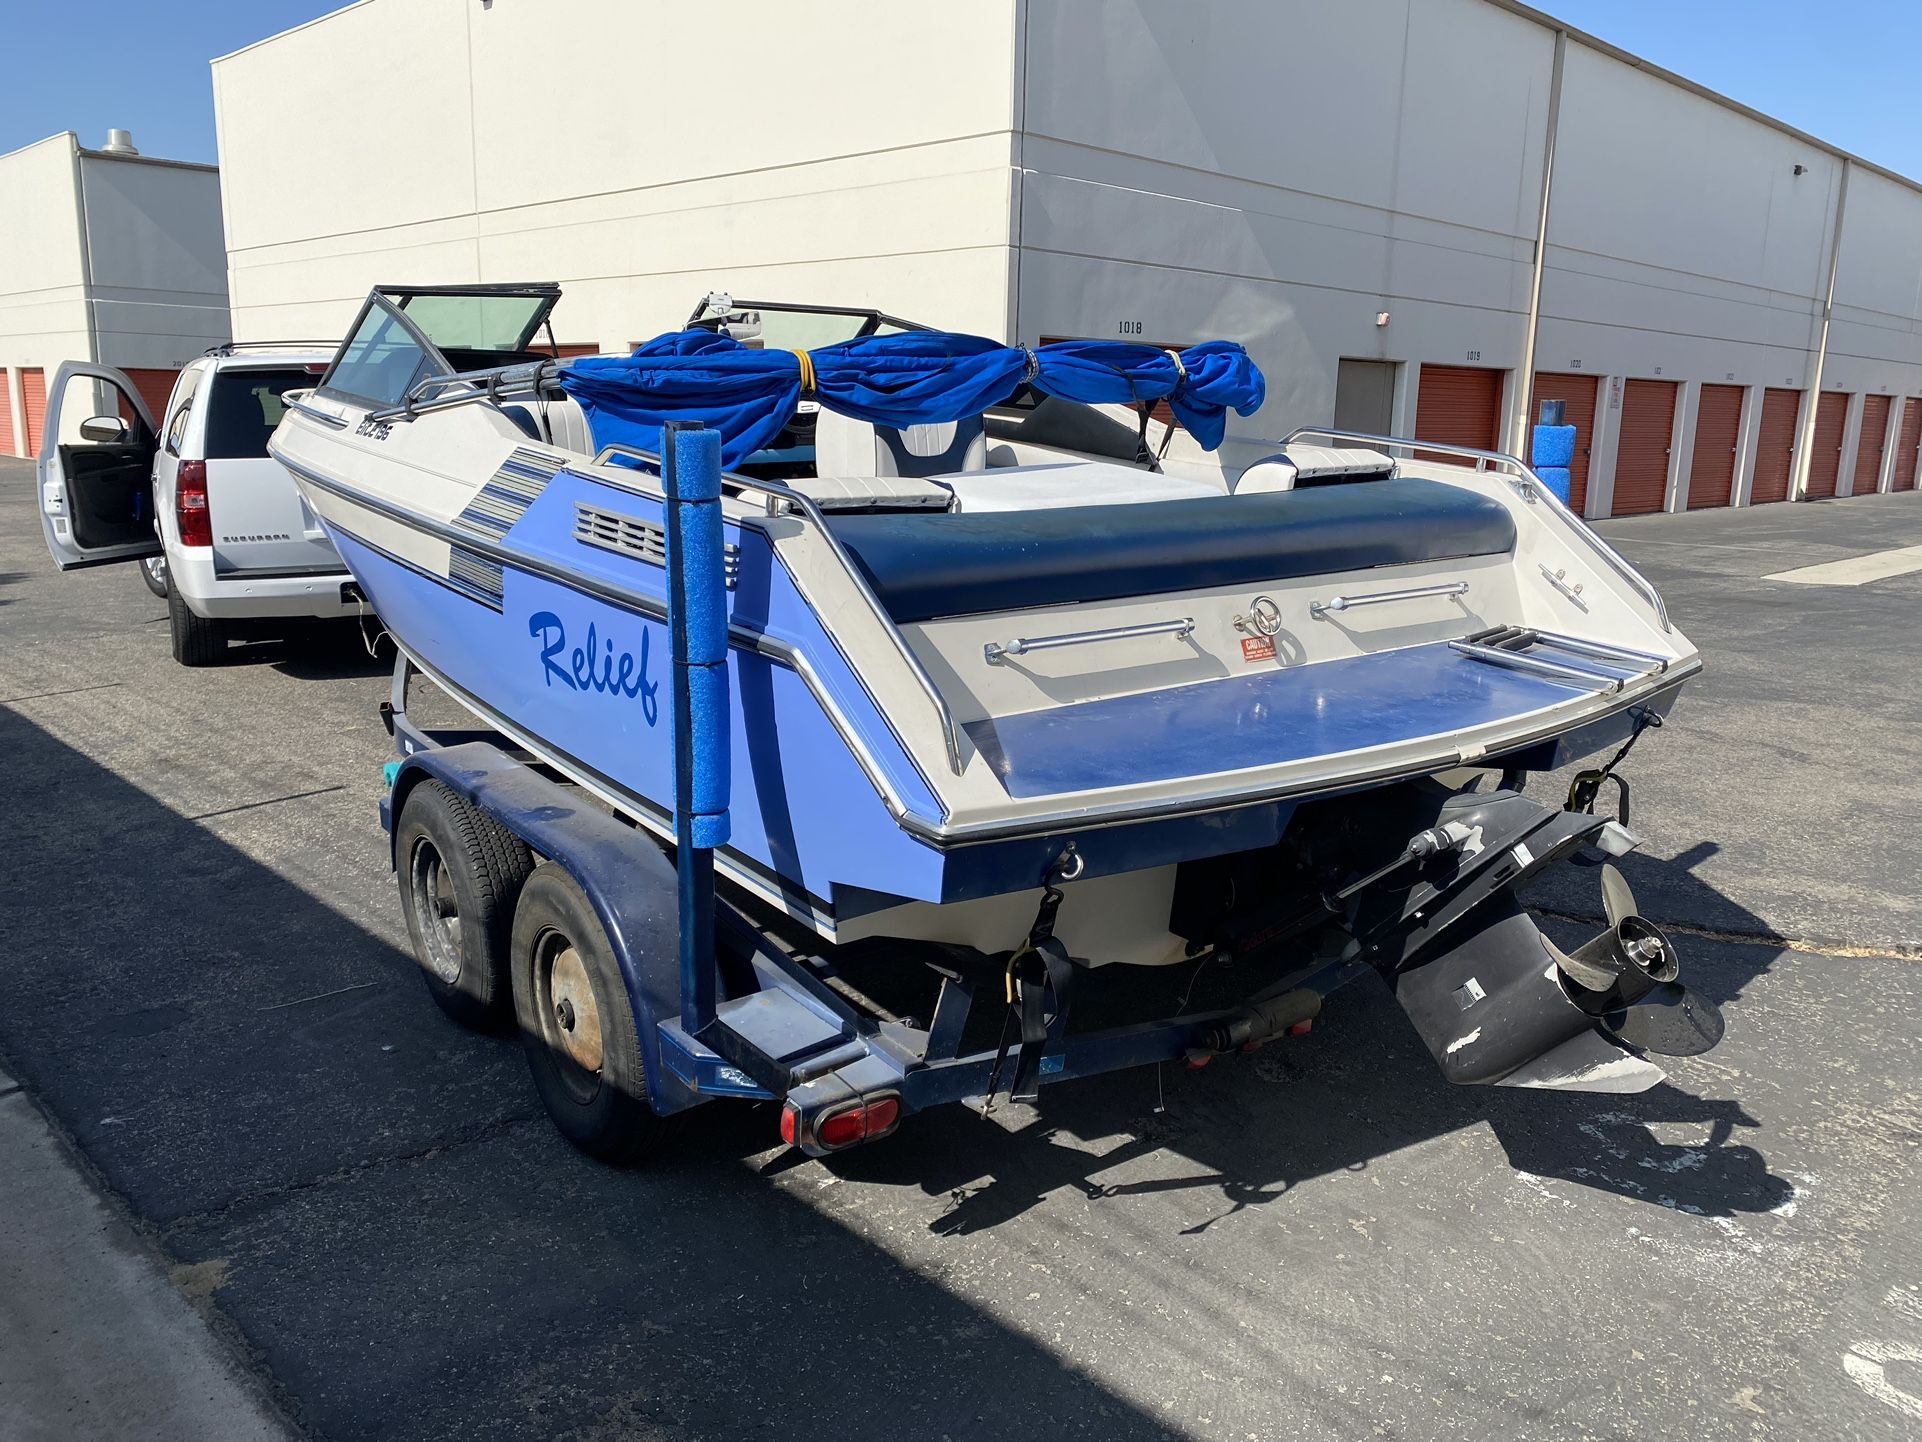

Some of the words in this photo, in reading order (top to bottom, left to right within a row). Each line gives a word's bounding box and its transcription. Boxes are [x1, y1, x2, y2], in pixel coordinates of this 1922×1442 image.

[1119, 321, 1142, 335] 1018
[1466, 351, 1481, 361] 1019
[222, 534, 291, 543] SUBURBAN
[1245, 637, 1271, 651] CAUTION
[528, 610, 659, 728] Relief
